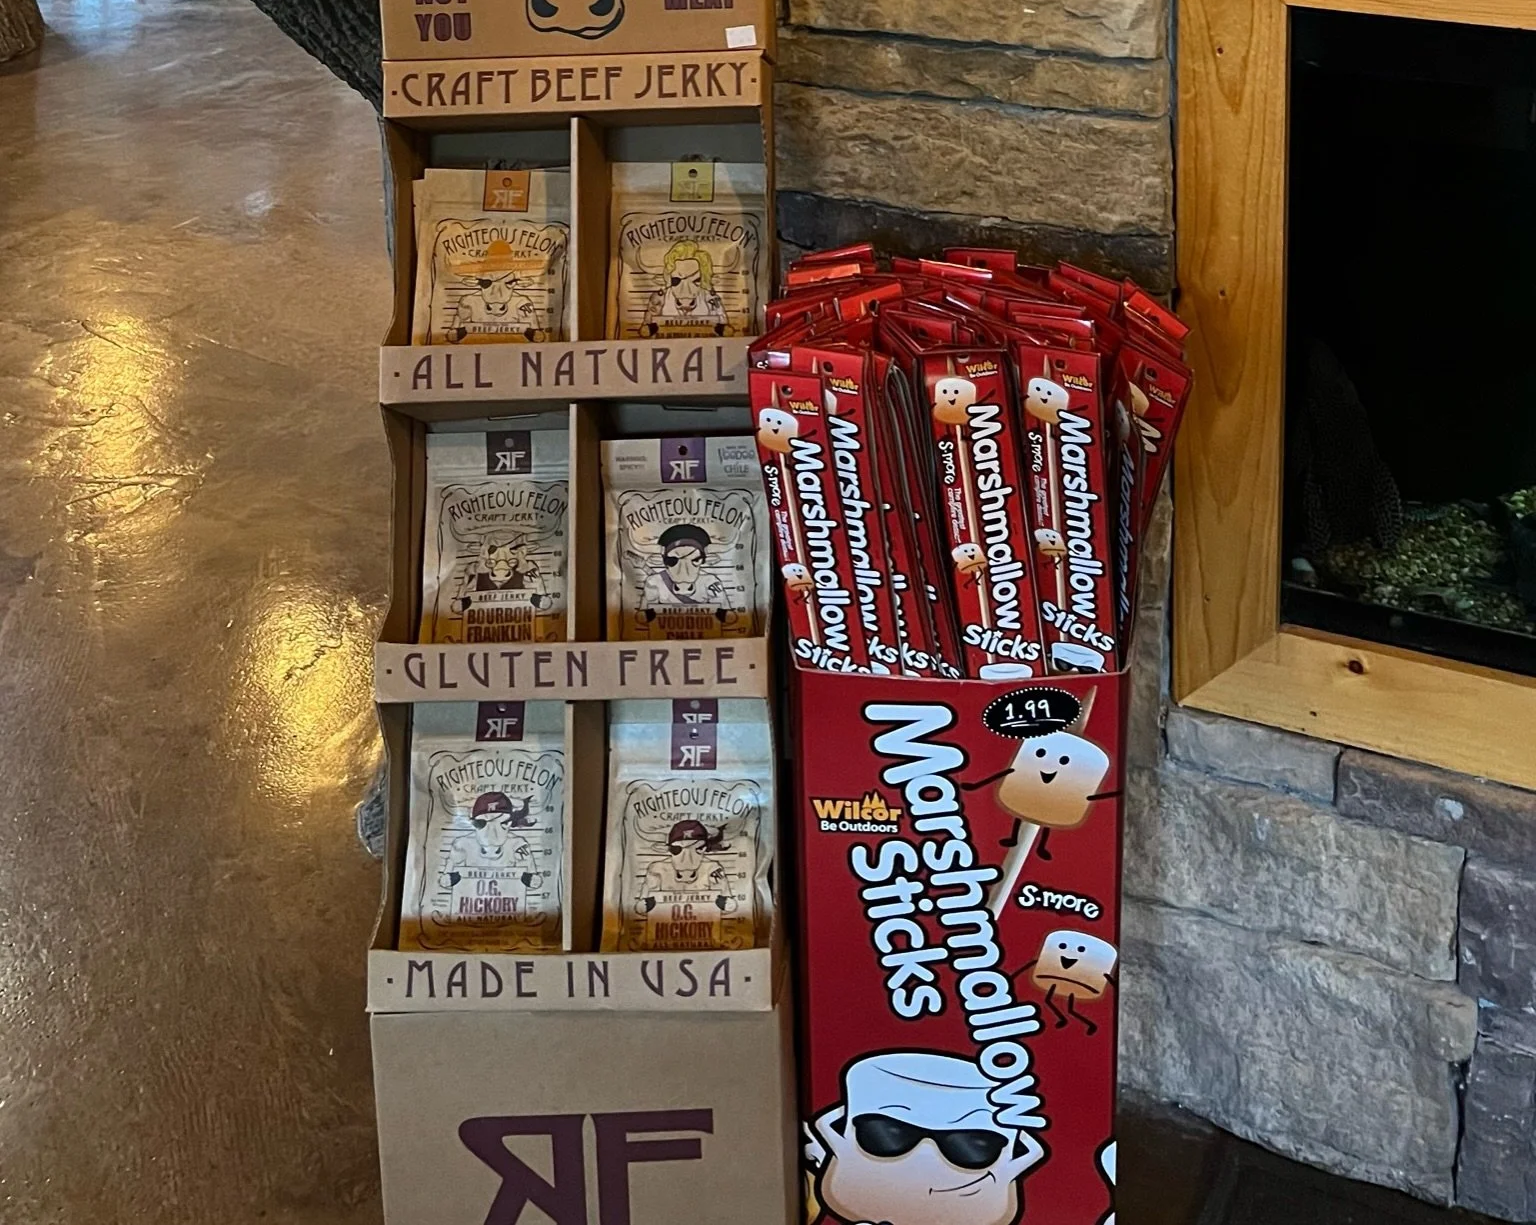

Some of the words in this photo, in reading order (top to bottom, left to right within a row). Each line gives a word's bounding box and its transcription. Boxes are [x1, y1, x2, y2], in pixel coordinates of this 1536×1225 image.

[415, 12, 472, 42] YOU
[401, 68, 519, 107] CRAFT
[531, 66, 623, 103] BEEF
[634, 62, 749, 100] JERKY
[442, 228, 519, 257] RIGHTEOUS
[518, 230, 562, 257] FELON
[626, 216, 707, 248] RIGHTEOUS
[708, 218, 752, 248] FELON
[412, 353, 493, 390] ALL
[521, 346, 736, 387] NATURAL
[448, 490, 525, 523] RIGHTEOUS
[527, 491, 568, 519] FELON
[474, 514, 506, 522] CRAFT
[509, 513, 539, 522] JERKY
[626, 497, 701, 531] RIGHTEOUS
[705, 499, 750, 528] FELON
[967, 404, 1023, 630] Marshmallow
[1059, 410, 1103, 619] Marshmallow
[828, 417, 882, 632] Marshmallow
[789, 438, 850, 653] Marshmallow
[478, 593, 497, 601] BEEF
[500, 593, 525, 601] JERKY
[467, 607, 533, 625] BOURBON
[657, 616, 714, 630] VOODOO
[1041, 601, 1115, 652] Sticks
[467, 625, 532, 643] FRANKLIN
[963, 625, 1041, 661] Sticks
[403, 649, 588, 688] GLUTEN
[619, 647, 737, 686] FREE
[1004, 699, 1052, 721] 1.99
[436, 759, 514, 793] RIGHTEOUS
[516, 760, 560, 790] FELON
[463, 784, 495, 793] CRAFT
[500, 783, 530, 793] JERKY
[633, 788, 709, 820] RIGHTEOUS
[710, 790, 755, 819] FELON
[660, 812, 692, 821] CRAFT
[696, 811, 724, 821] JERKY
[812, 799, 902, 821] Wilcor
[820, 820, 837, 831] Be
[839, 820, 898, 834] Outdoors
[467, 870, 487, 878] BEEF
[491, 870, 516, 878] JERKY
[476, 879, 502, 896] O.G.
[459, 896, 519, 914] HICKORY
[663, 895, 682, 903] BEEF
[685, 894, 711, 902] JERKY
[671, 904, 697, 921] O.G.
[476, 914, 518, 922] NATURAL
[655, 921, 714, 940] HICKORY
[852, 841, 948, 1018] Sticks
[864, 703, 1047, 1129] Marshmallow
[405, 960, 538, 999] MADE
[567, 960, 611, 999] IN
[641, 957, 732, 999] USA
